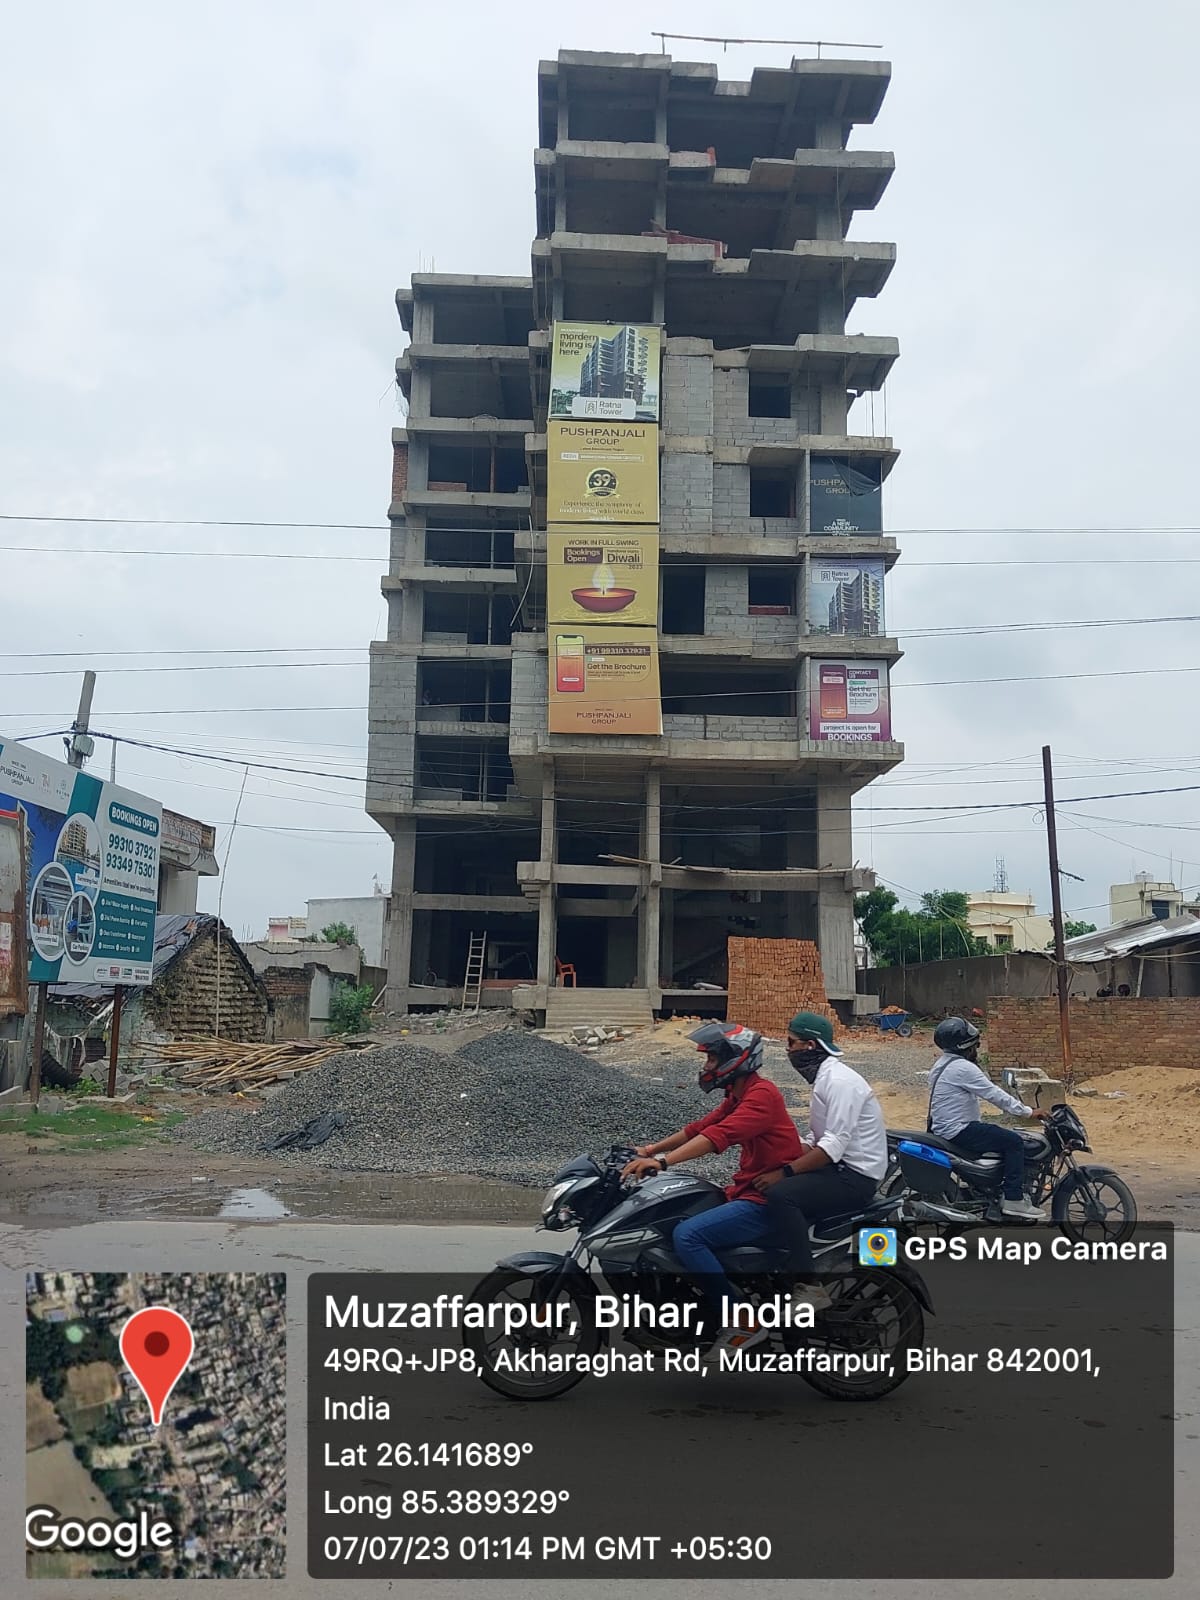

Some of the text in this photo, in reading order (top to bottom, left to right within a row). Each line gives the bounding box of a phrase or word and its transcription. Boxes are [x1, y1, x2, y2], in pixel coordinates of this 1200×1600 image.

[560, 332, 598, 340] mordern
[560, 340, 583, 349] living
[560, 428, 646, 437] PUSHPANJALI
[593, 474, 611, 486] 39
[608, 553, 640, 562] Diwali
[112, 807, 157, 833] BOOKINGS OPEN
[109, 833, 156, 860] 99310 37921
[106, 853, 155, 879] 93349 75301
